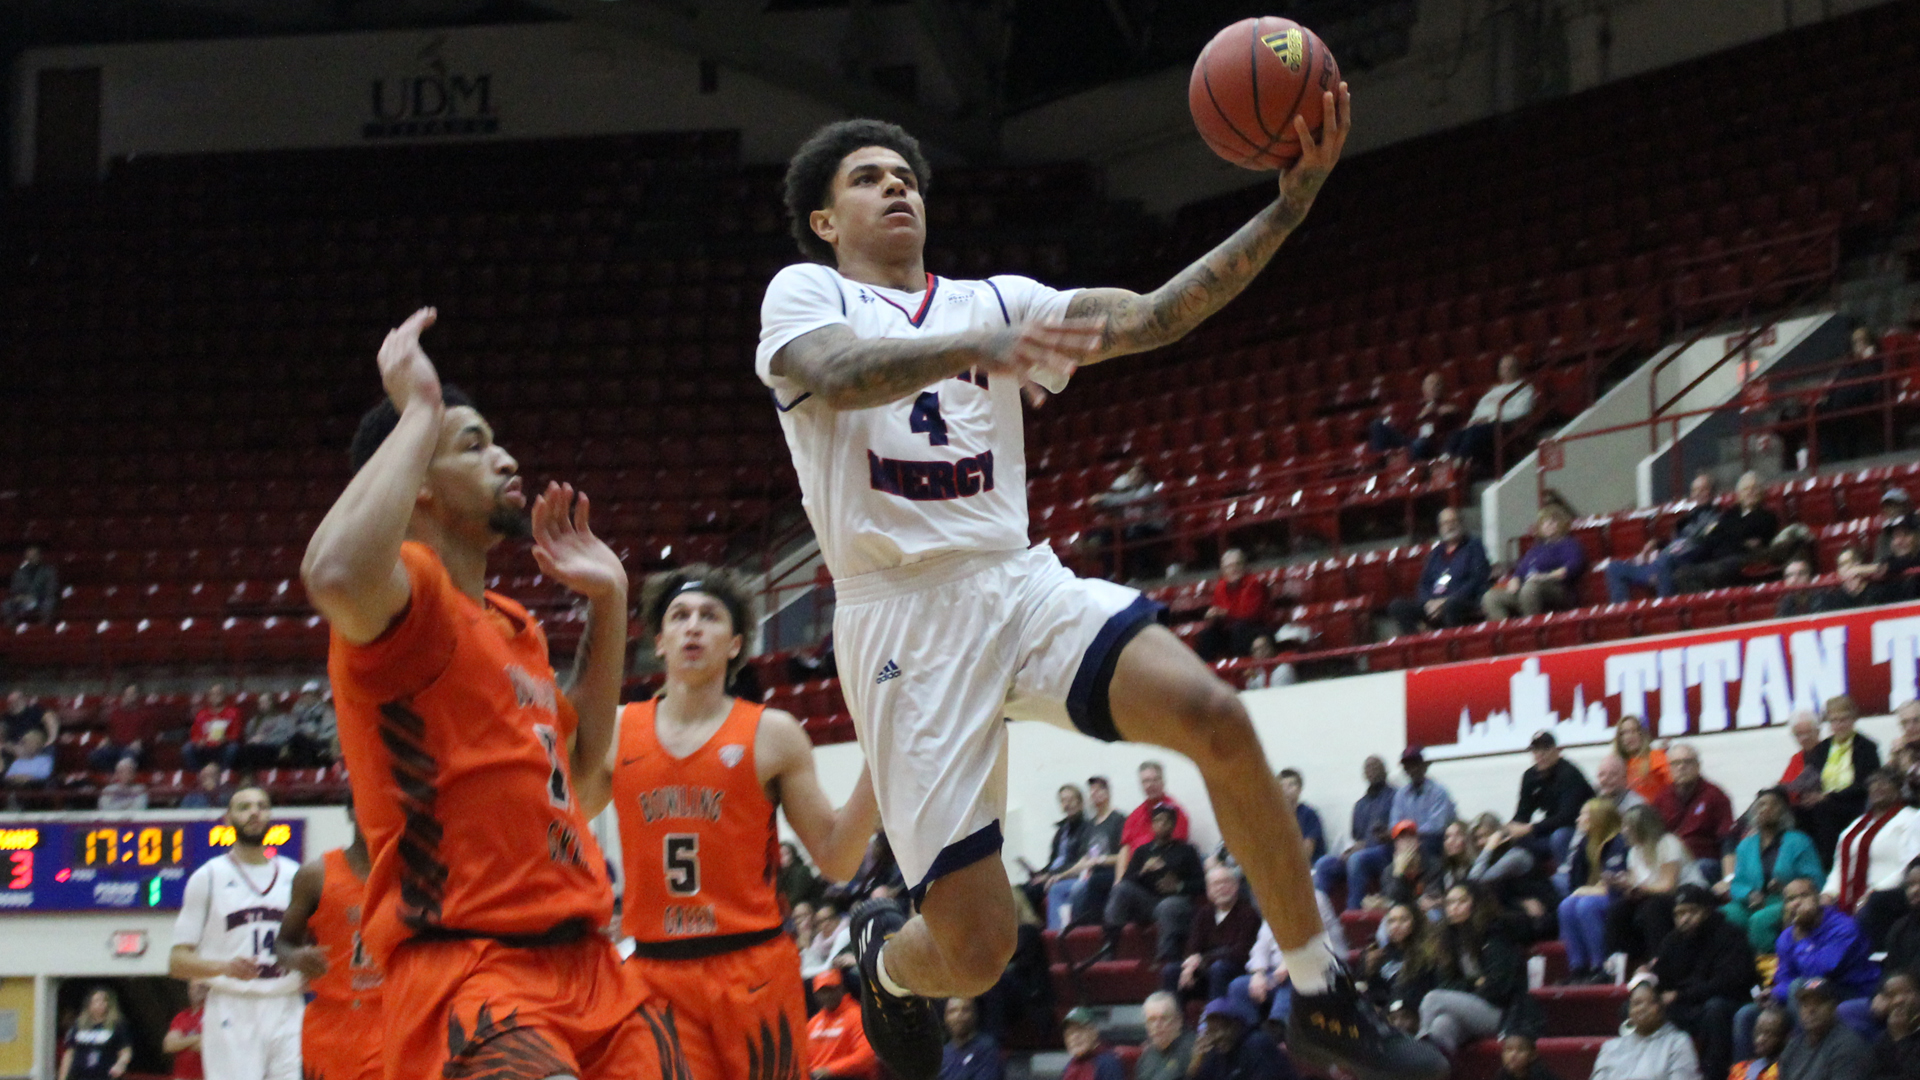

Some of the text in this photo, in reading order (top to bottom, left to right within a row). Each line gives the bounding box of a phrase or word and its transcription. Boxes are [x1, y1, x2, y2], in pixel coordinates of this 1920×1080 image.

[909, 391, 949, 446] 4
[867, 449, 994, 501] MERCY
[1605, 626, 1849, 737] TITAN
[85, 827, 183, 866] 17:01
[662, 832, 700, 897] 5
